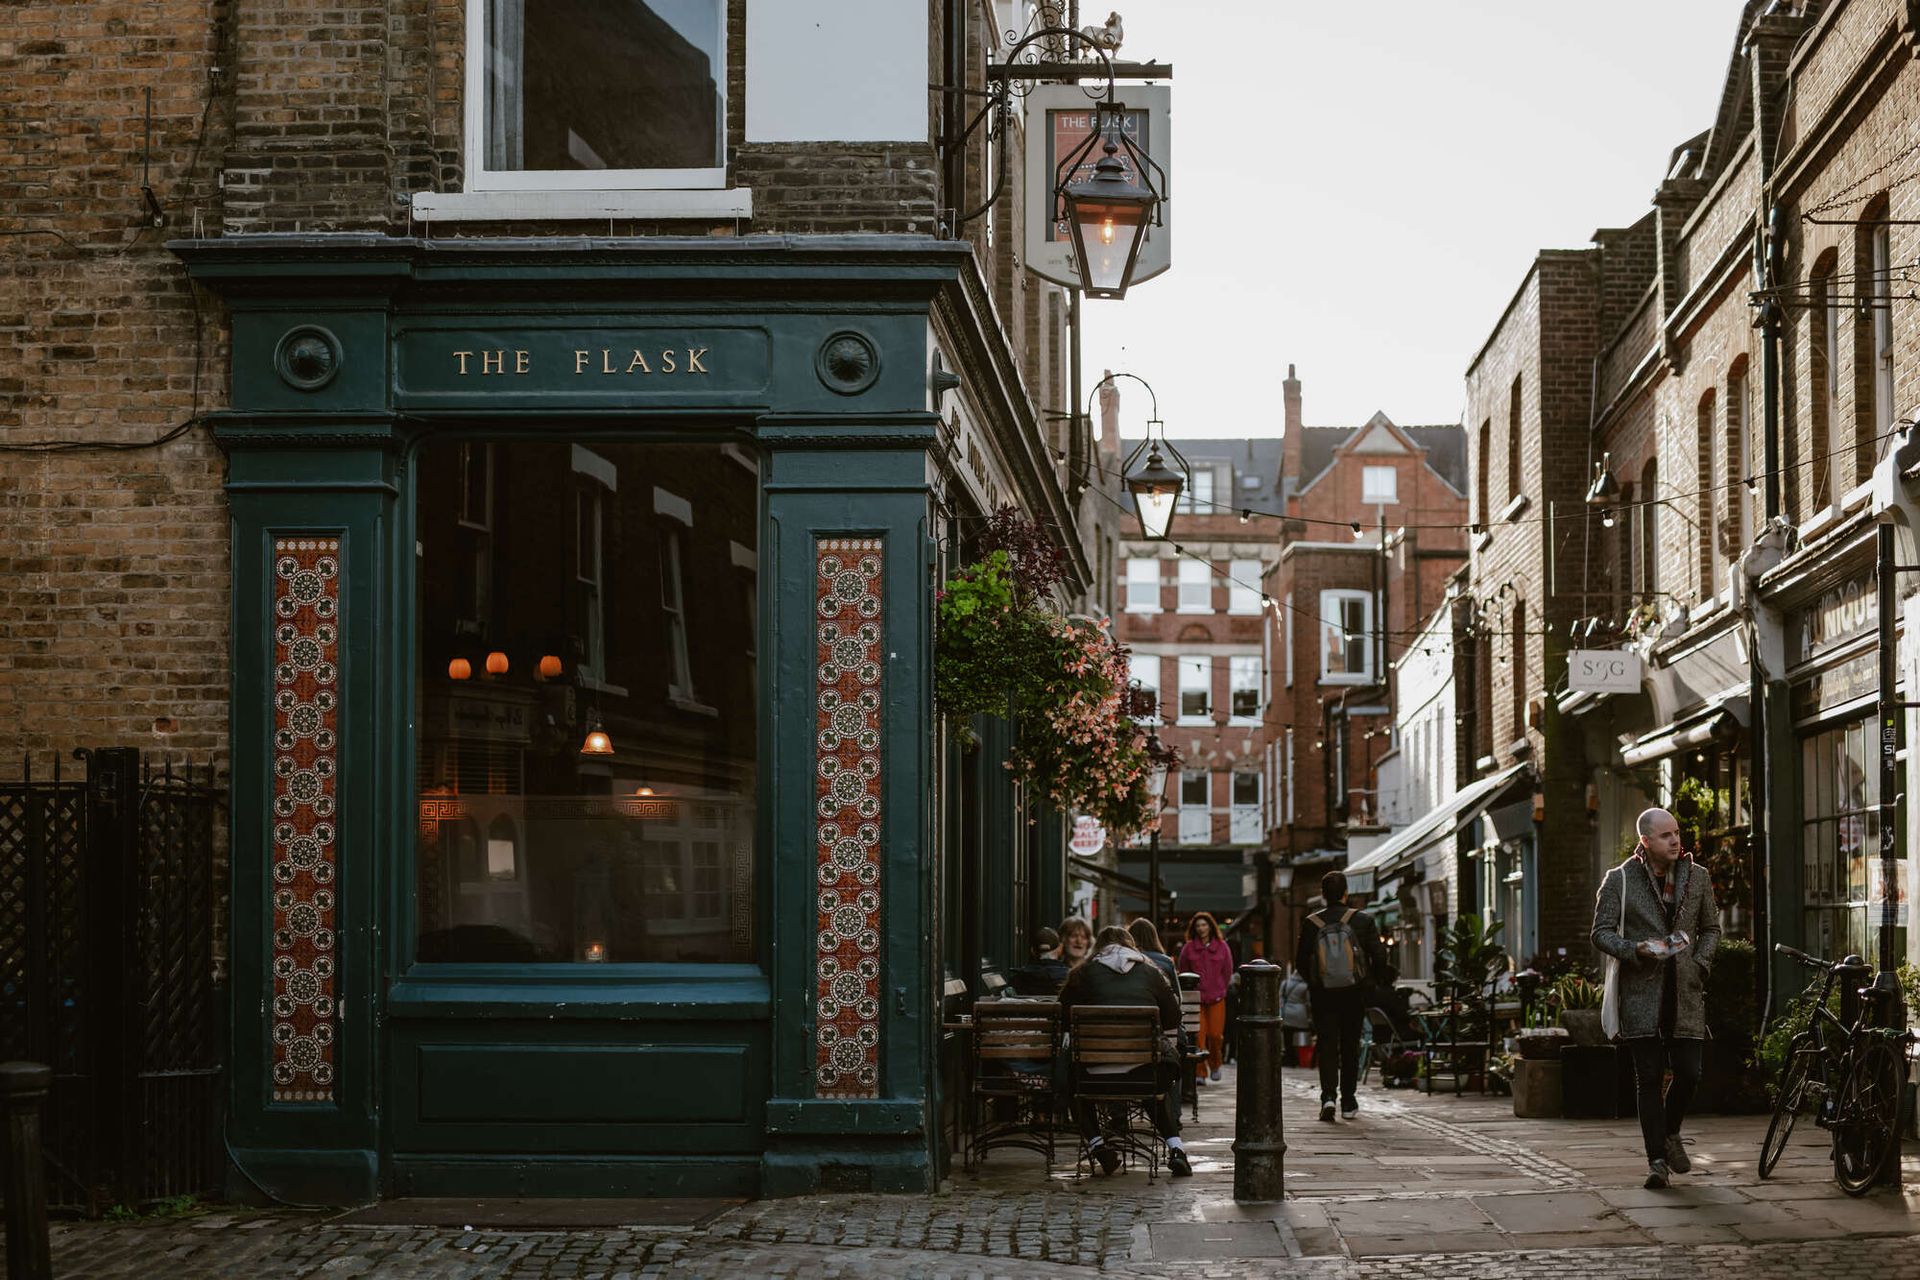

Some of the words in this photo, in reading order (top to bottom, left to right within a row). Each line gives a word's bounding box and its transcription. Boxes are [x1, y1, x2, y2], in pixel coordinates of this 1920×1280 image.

[1061, 116, 1086, 128] THE
[453, 350, 530, 375] THE
[575, 348, 709, 374] FLASK
